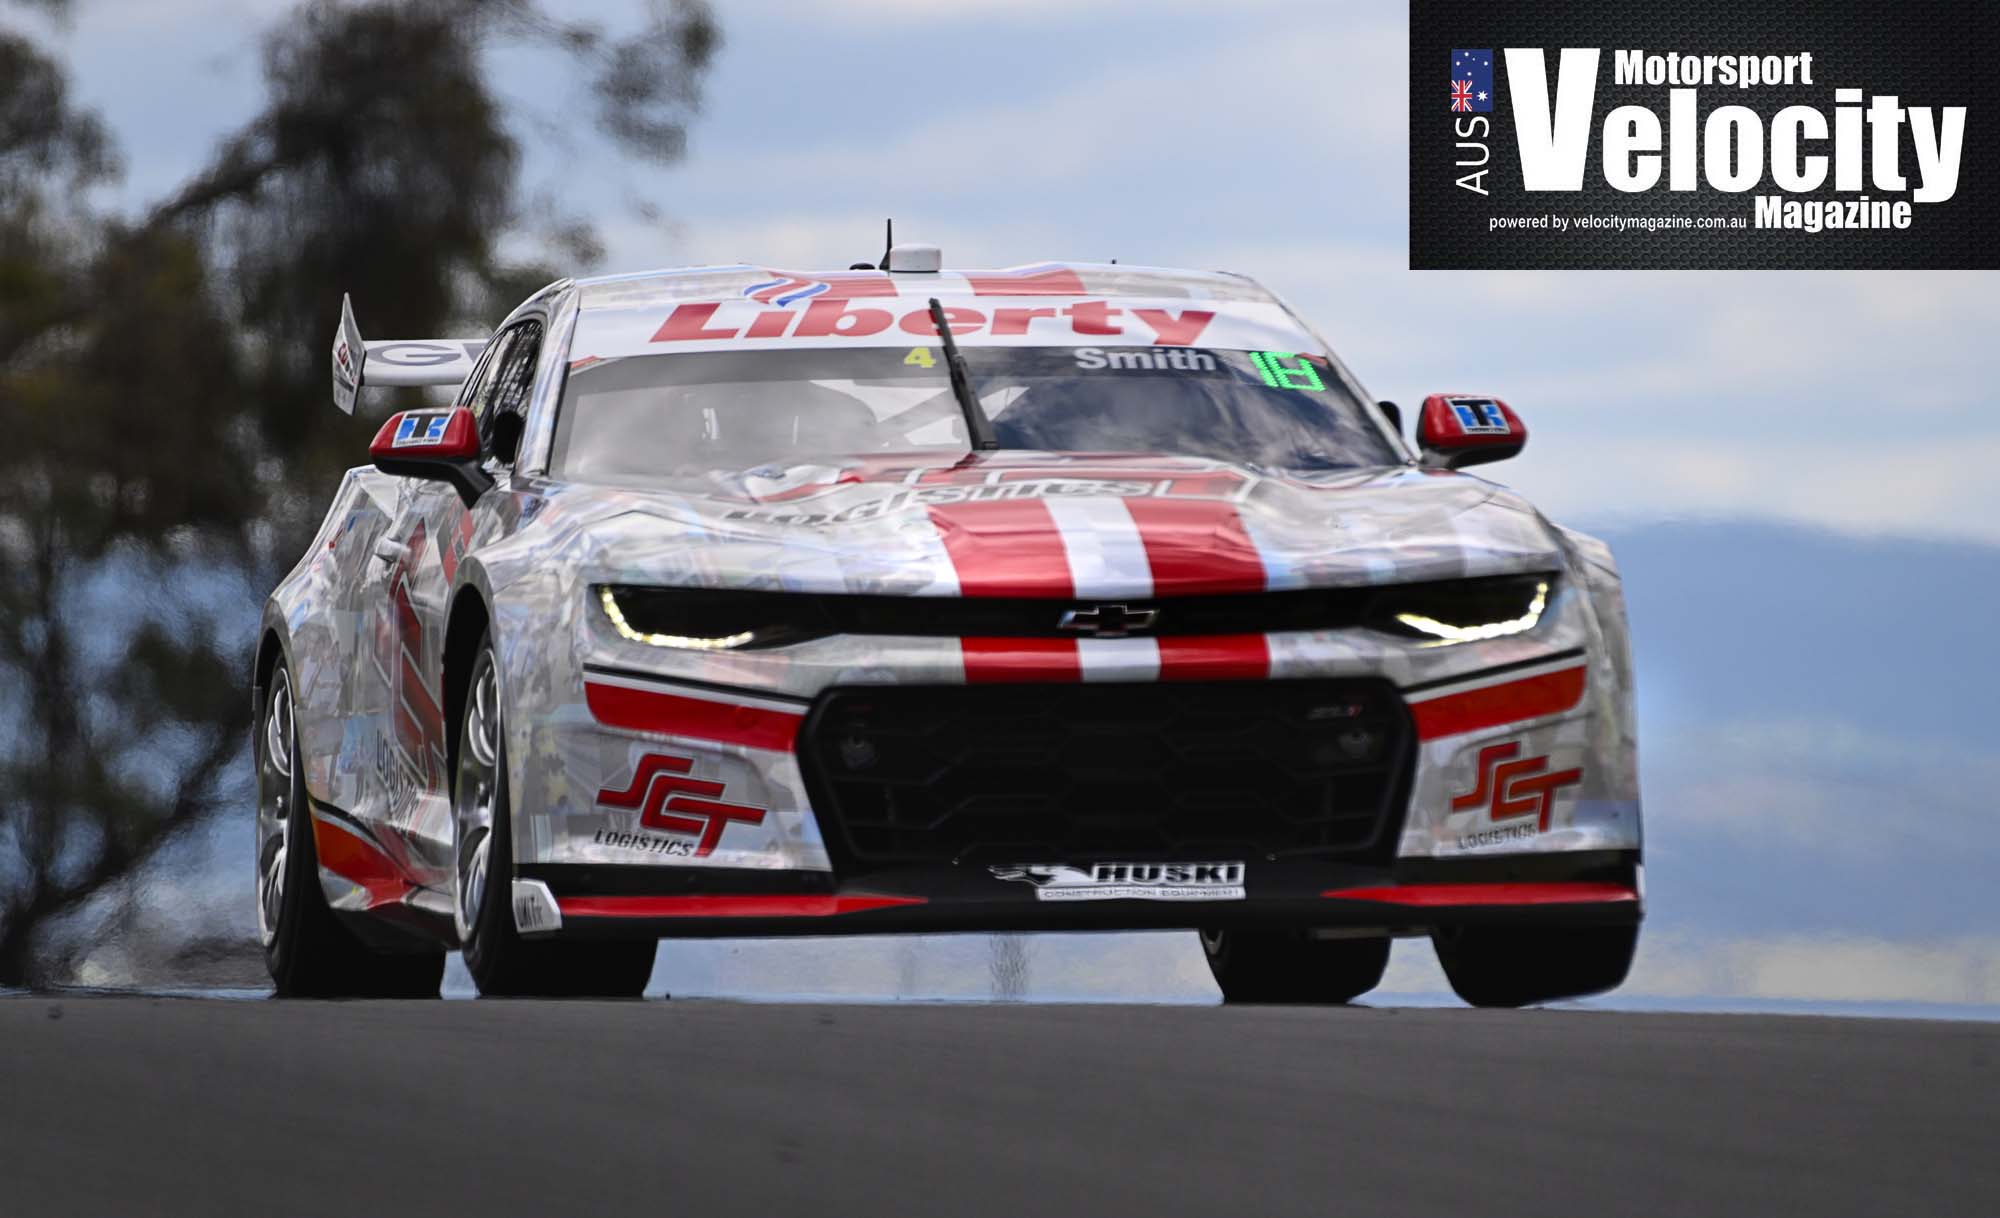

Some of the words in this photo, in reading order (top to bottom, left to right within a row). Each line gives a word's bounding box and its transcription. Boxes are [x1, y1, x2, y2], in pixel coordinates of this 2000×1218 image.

[649, 300, 1216, 345] Liberty
[904, 347, 937, 368] 4
[1074, 348, 1216, 371] Smith
[1452, 741, 1583, 832] SCT
[596, 753, 767, 857] SCT
[594, 829, 694, 857] LOGISTICS
[1457, 823, 1536, 850] LOGISTICS
[1094, 862, 1245, 886] HUSKI
[1043, 888, 1156, 898] CONSTRUCTION
